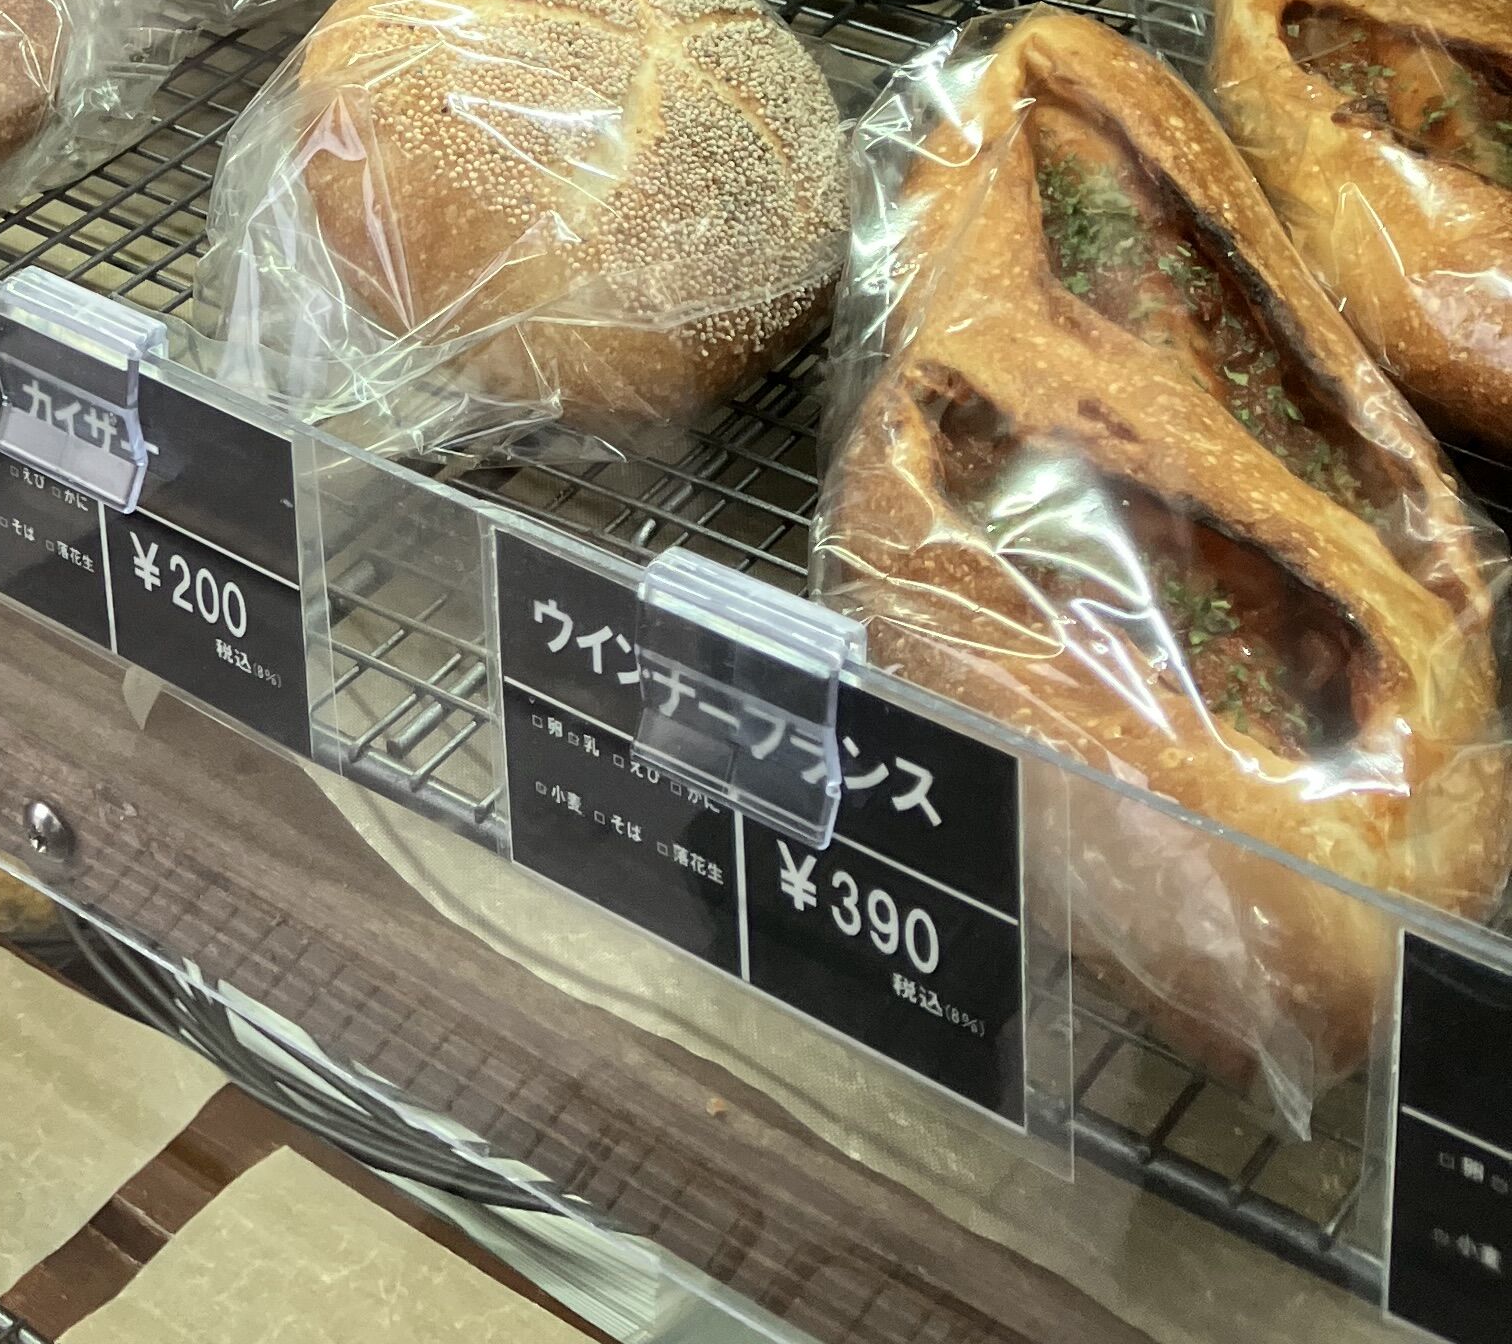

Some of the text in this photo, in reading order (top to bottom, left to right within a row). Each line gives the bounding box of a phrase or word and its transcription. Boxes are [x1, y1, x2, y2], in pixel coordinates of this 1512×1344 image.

[22, 379, 160, 455] カイザー
[129, 531, 247, 639] ¥200
[534, 599, 942, 827] ウインナーフランス
[552, 785, 583, 815] 小麦
[777, 840, 939, 974] ¥390
